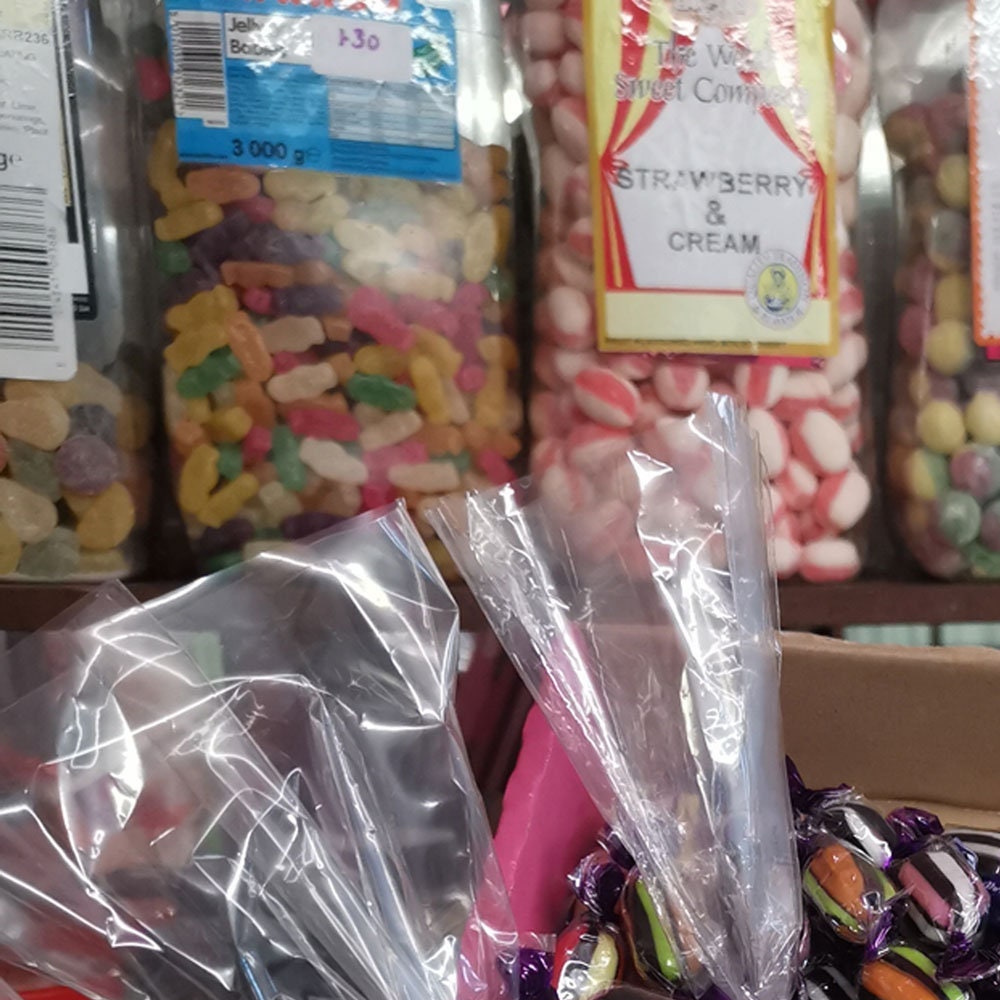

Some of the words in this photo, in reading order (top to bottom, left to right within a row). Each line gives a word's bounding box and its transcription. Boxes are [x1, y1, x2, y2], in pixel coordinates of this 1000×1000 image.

[232, 139, 245, 157] 3
[249, 140, 287, 159] 000
[615, 168, 810, 197] STRAWBERRY
[705, 200, 727, 226] &
[667, 231, 761, 255] CREAM
